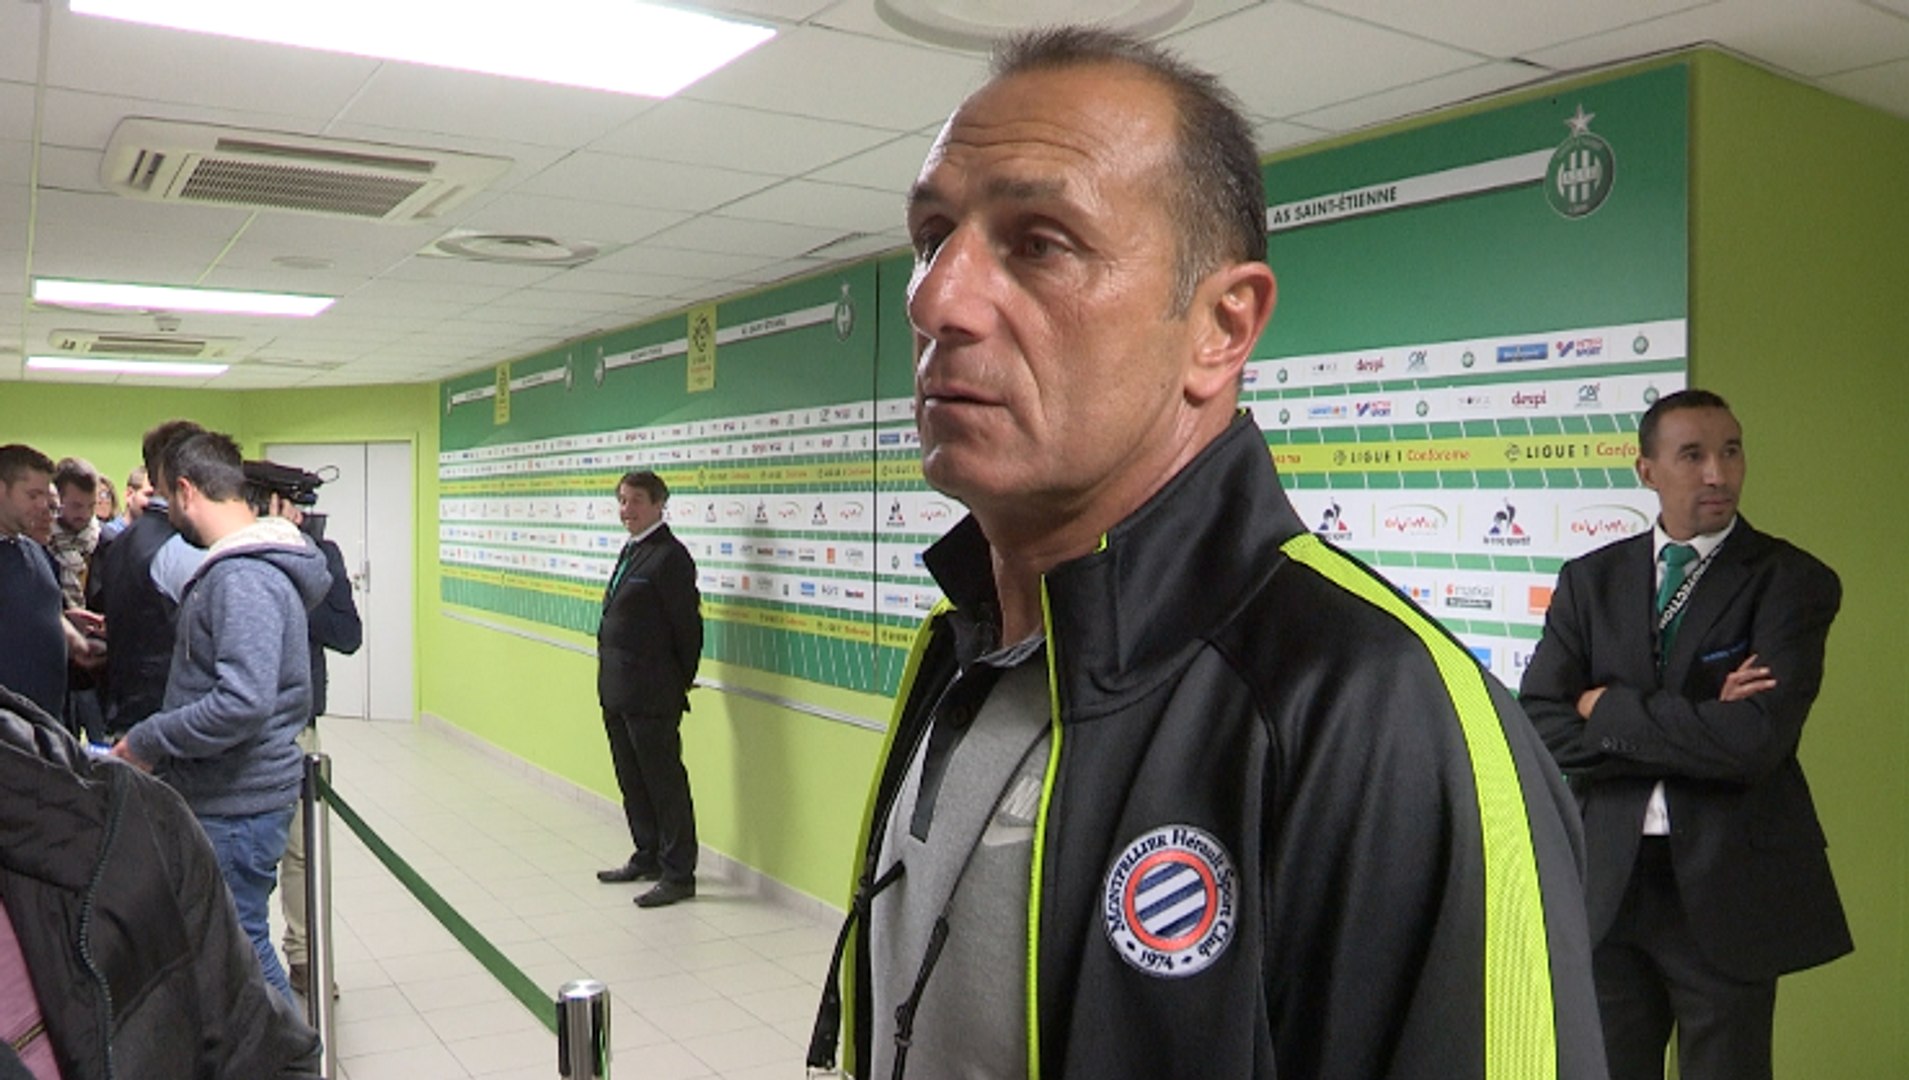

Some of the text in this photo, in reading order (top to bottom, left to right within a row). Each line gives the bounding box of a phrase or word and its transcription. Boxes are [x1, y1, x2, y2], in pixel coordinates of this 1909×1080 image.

[1273, 186, 1397, 224] AS SAINT-ÉTIENNE
[1526, 444, 1576, 460] LIGUE
[1596, 441, 1639, 459] Confo
[1139, 950, 1175, 971] 1974
